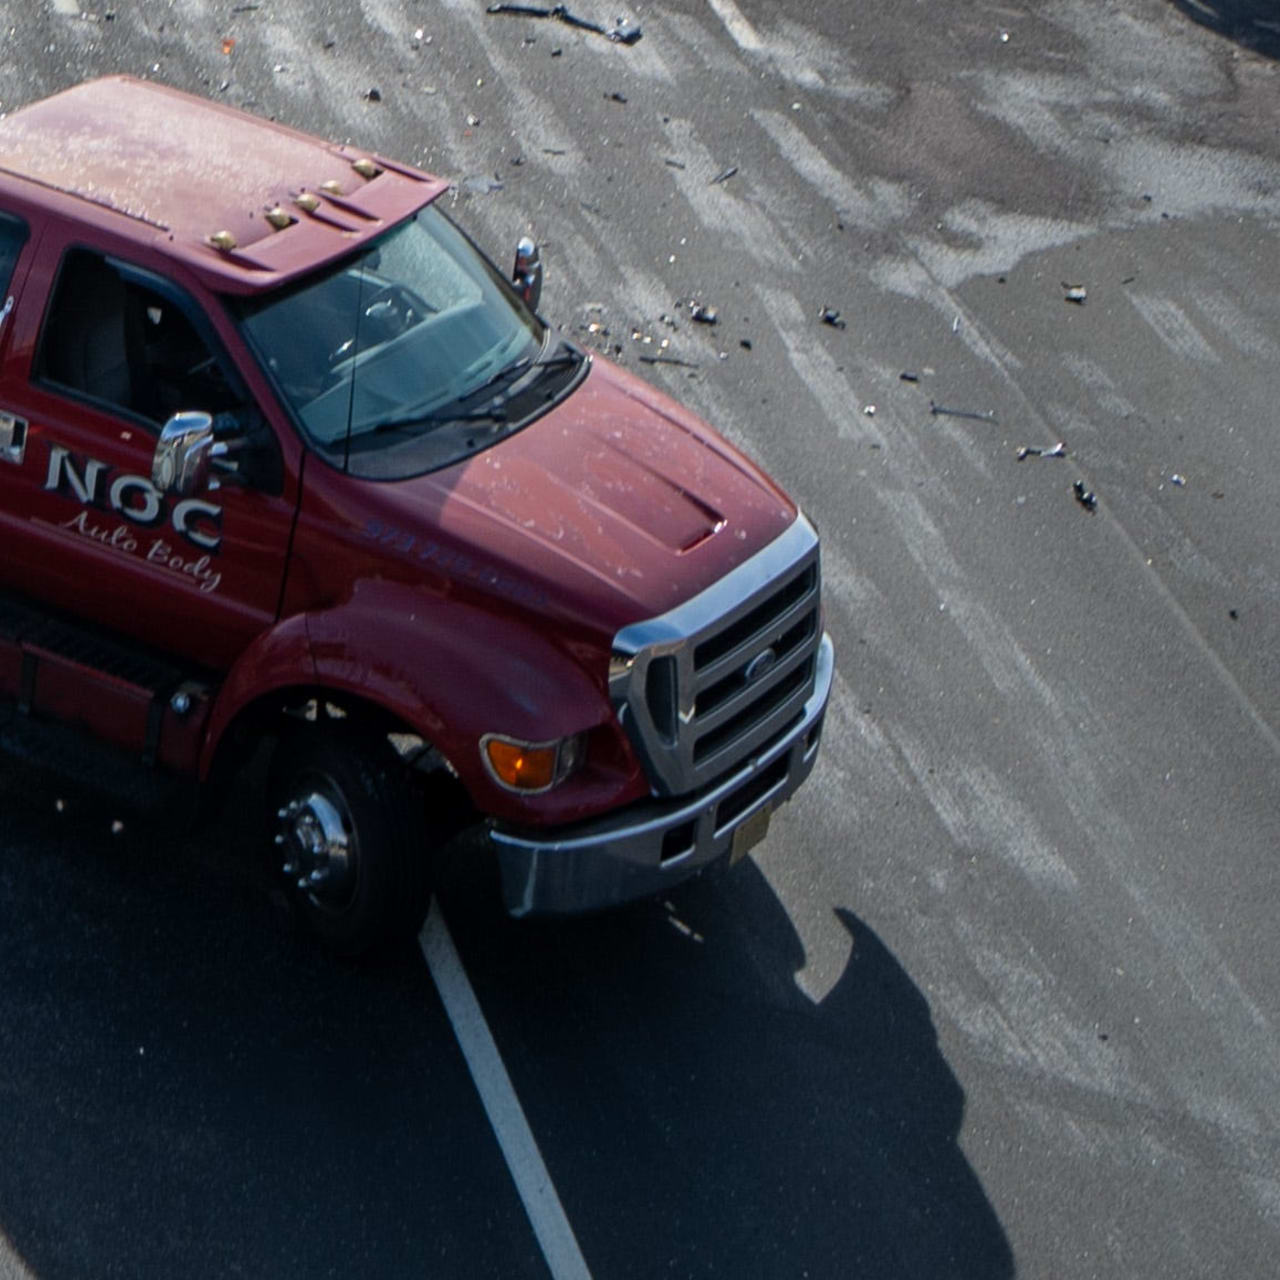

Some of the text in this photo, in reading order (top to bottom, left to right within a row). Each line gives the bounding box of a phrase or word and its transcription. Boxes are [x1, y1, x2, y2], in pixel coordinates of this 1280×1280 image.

[44, 445, 223, 549] NOC
[63, 511, 222, 593] Auto Body
